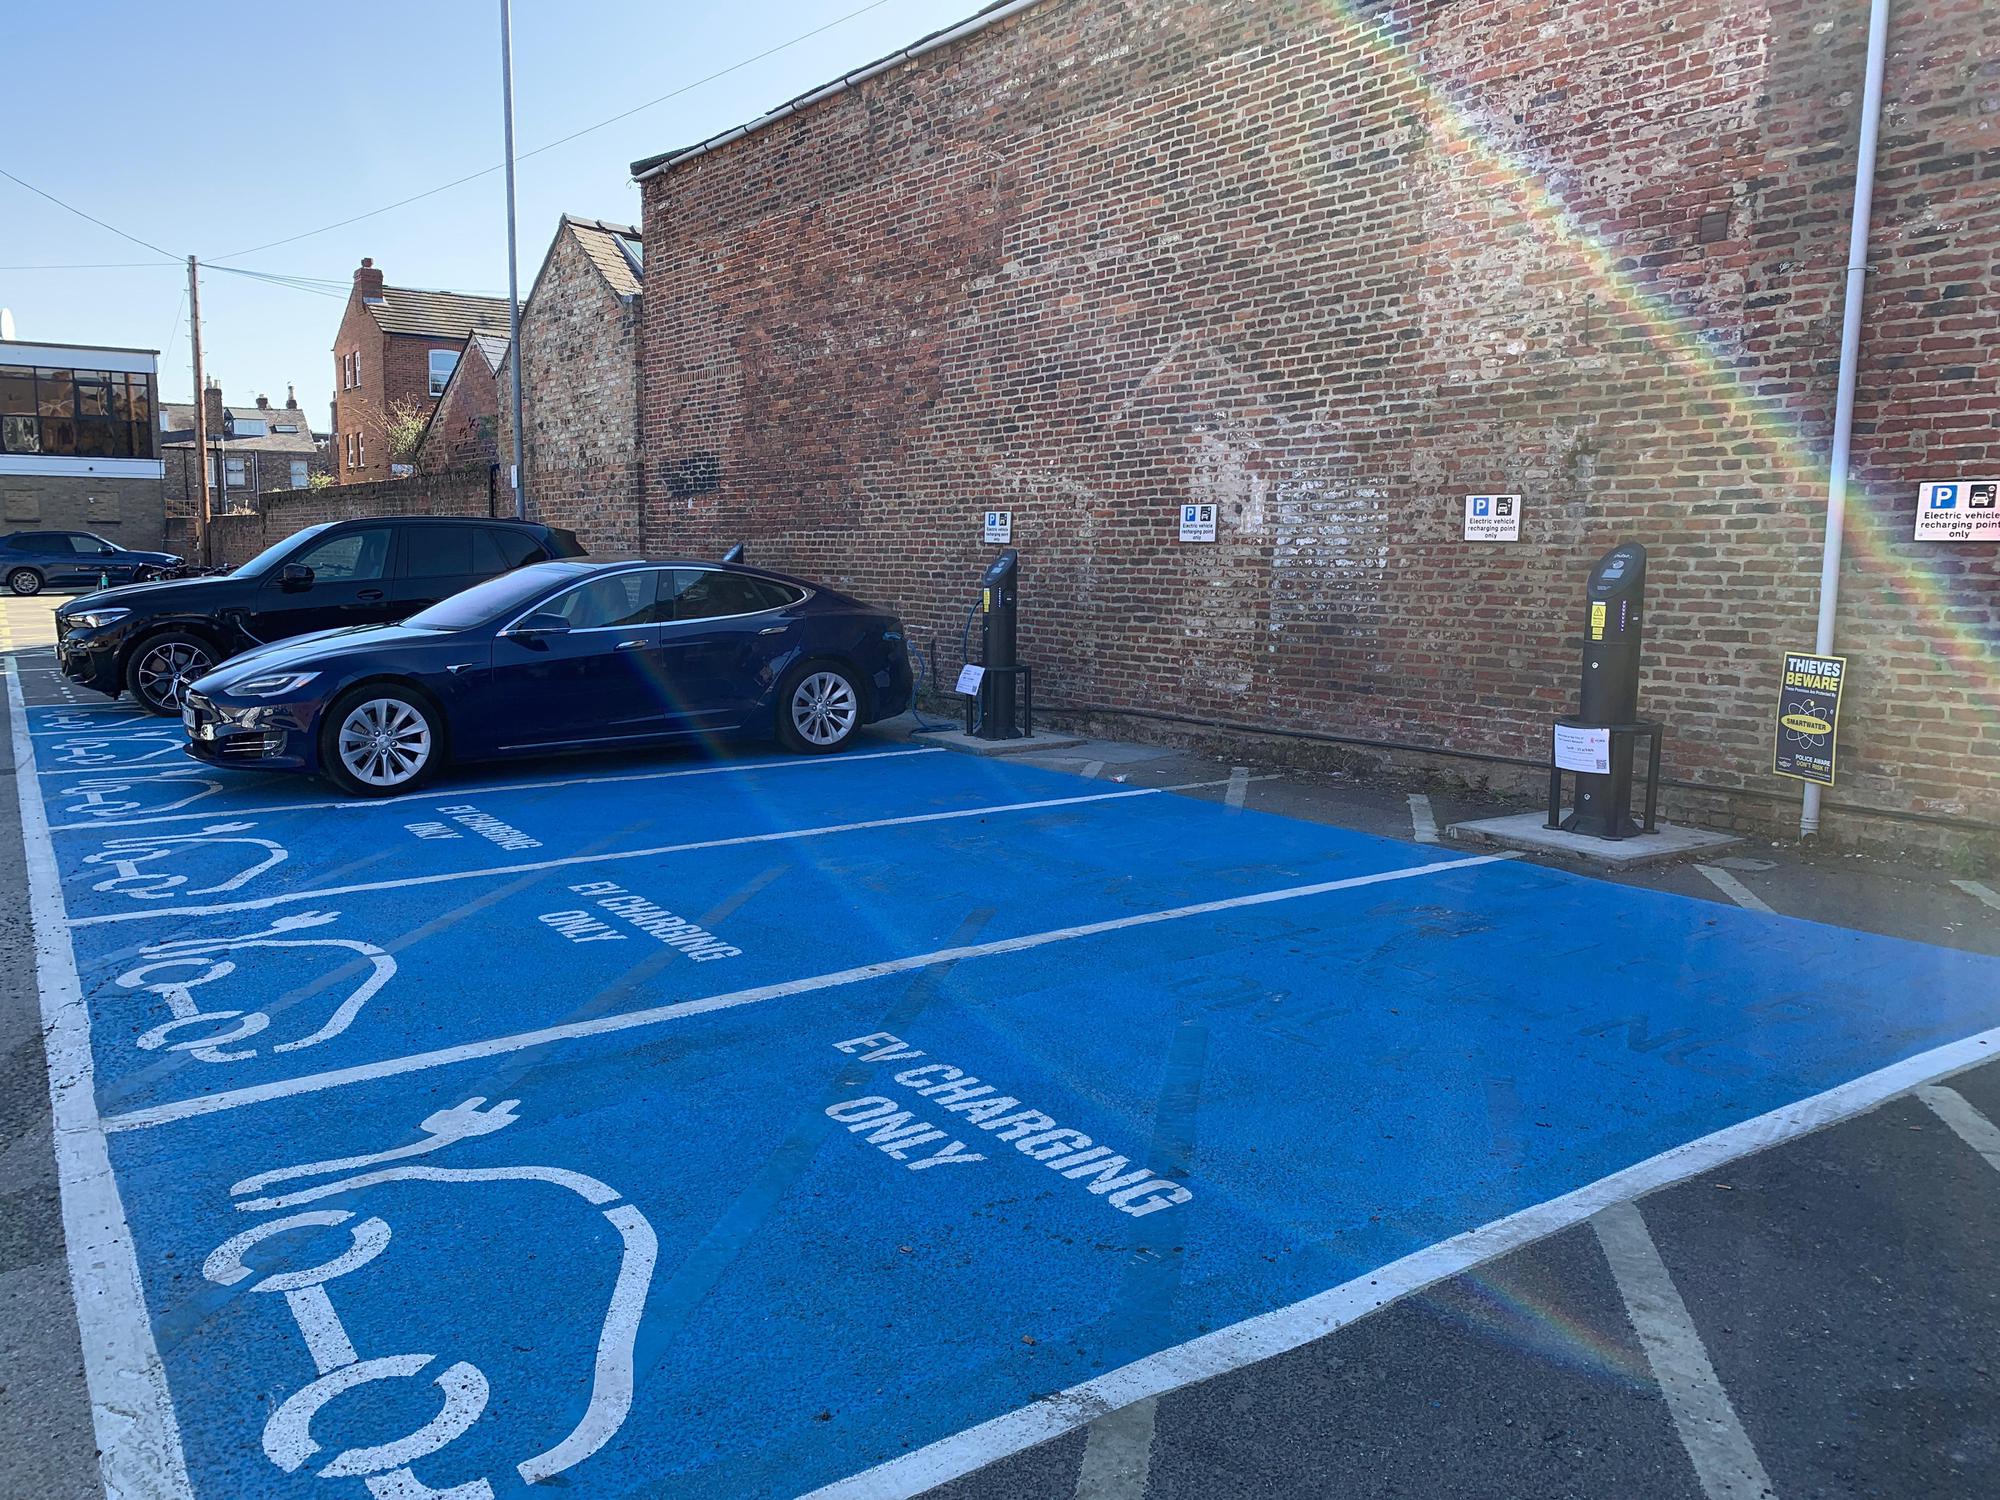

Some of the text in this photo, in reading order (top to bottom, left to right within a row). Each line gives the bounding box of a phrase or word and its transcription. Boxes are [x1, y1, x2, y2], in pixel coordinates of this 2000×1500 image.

[1936, 488, 1952, 506] P
[1187, 508, 1194, 520] P
[1476, 500, 1486, 514] P
[1924, 512, 2000, 520] Electric vehicle
[990, 514, 995, 525] P
[1920, 521, 2000, 530] recharging point
[1788, 658, 1840, 677] THIEVES
[1785, 672, 1840, 691] BEWARE
[1786, 718, 1826, 730] SMARTWATER
[1796, 754, 1813, 763] POLICE
[1814, 758, 1831, 766] AWARE
[404, 822, 464, 840] ONLY
[435, 804, 544, 851] EV CHARGING
[538, 910, 628, 944] ONLY
[568, 881, 743, 962] EV CHARGING
[824, 1096, 989, 1171] ONLY
[832, 1031, 1193, 1218] EV CHARGING
